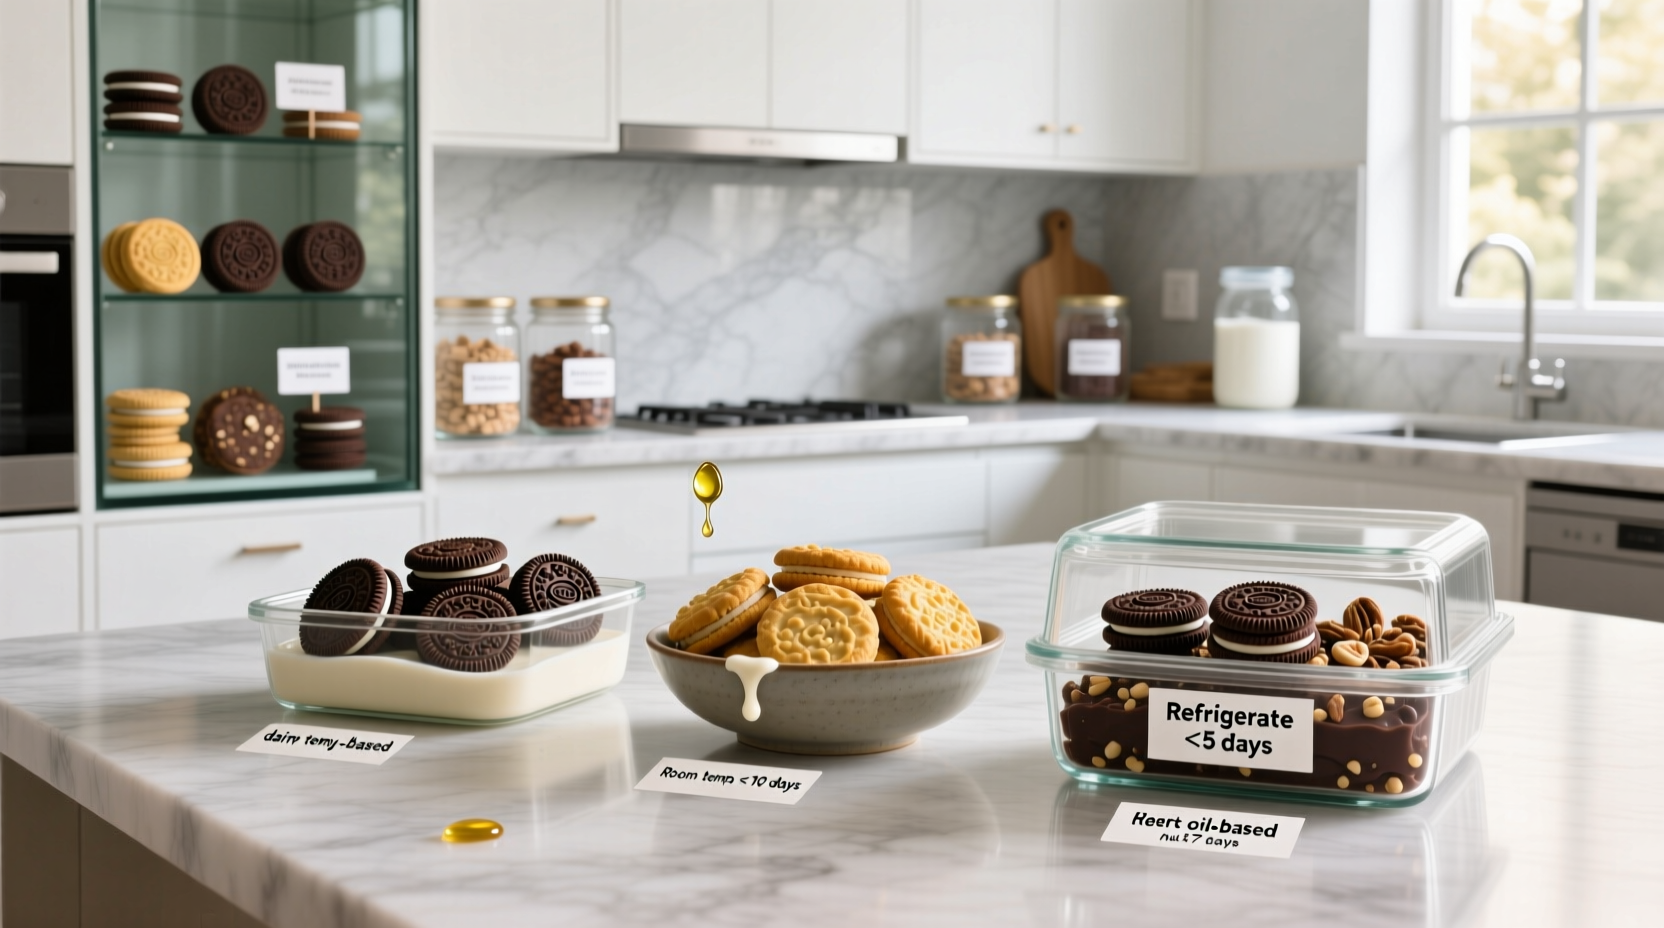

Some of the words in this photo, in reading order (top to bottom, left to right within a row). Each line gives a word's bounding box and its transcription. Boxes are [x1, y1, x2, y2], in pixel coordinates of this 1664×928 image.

[1166, 701, 1294, 729] Refrigerate
[1185, 730, 1216, 750] <5
[1221, 733, 1273, 759] days
[660, 766, 698, 780] Room
[768, 777, 802, 793] days
[1187, 817, 1279, 838] oil-based
